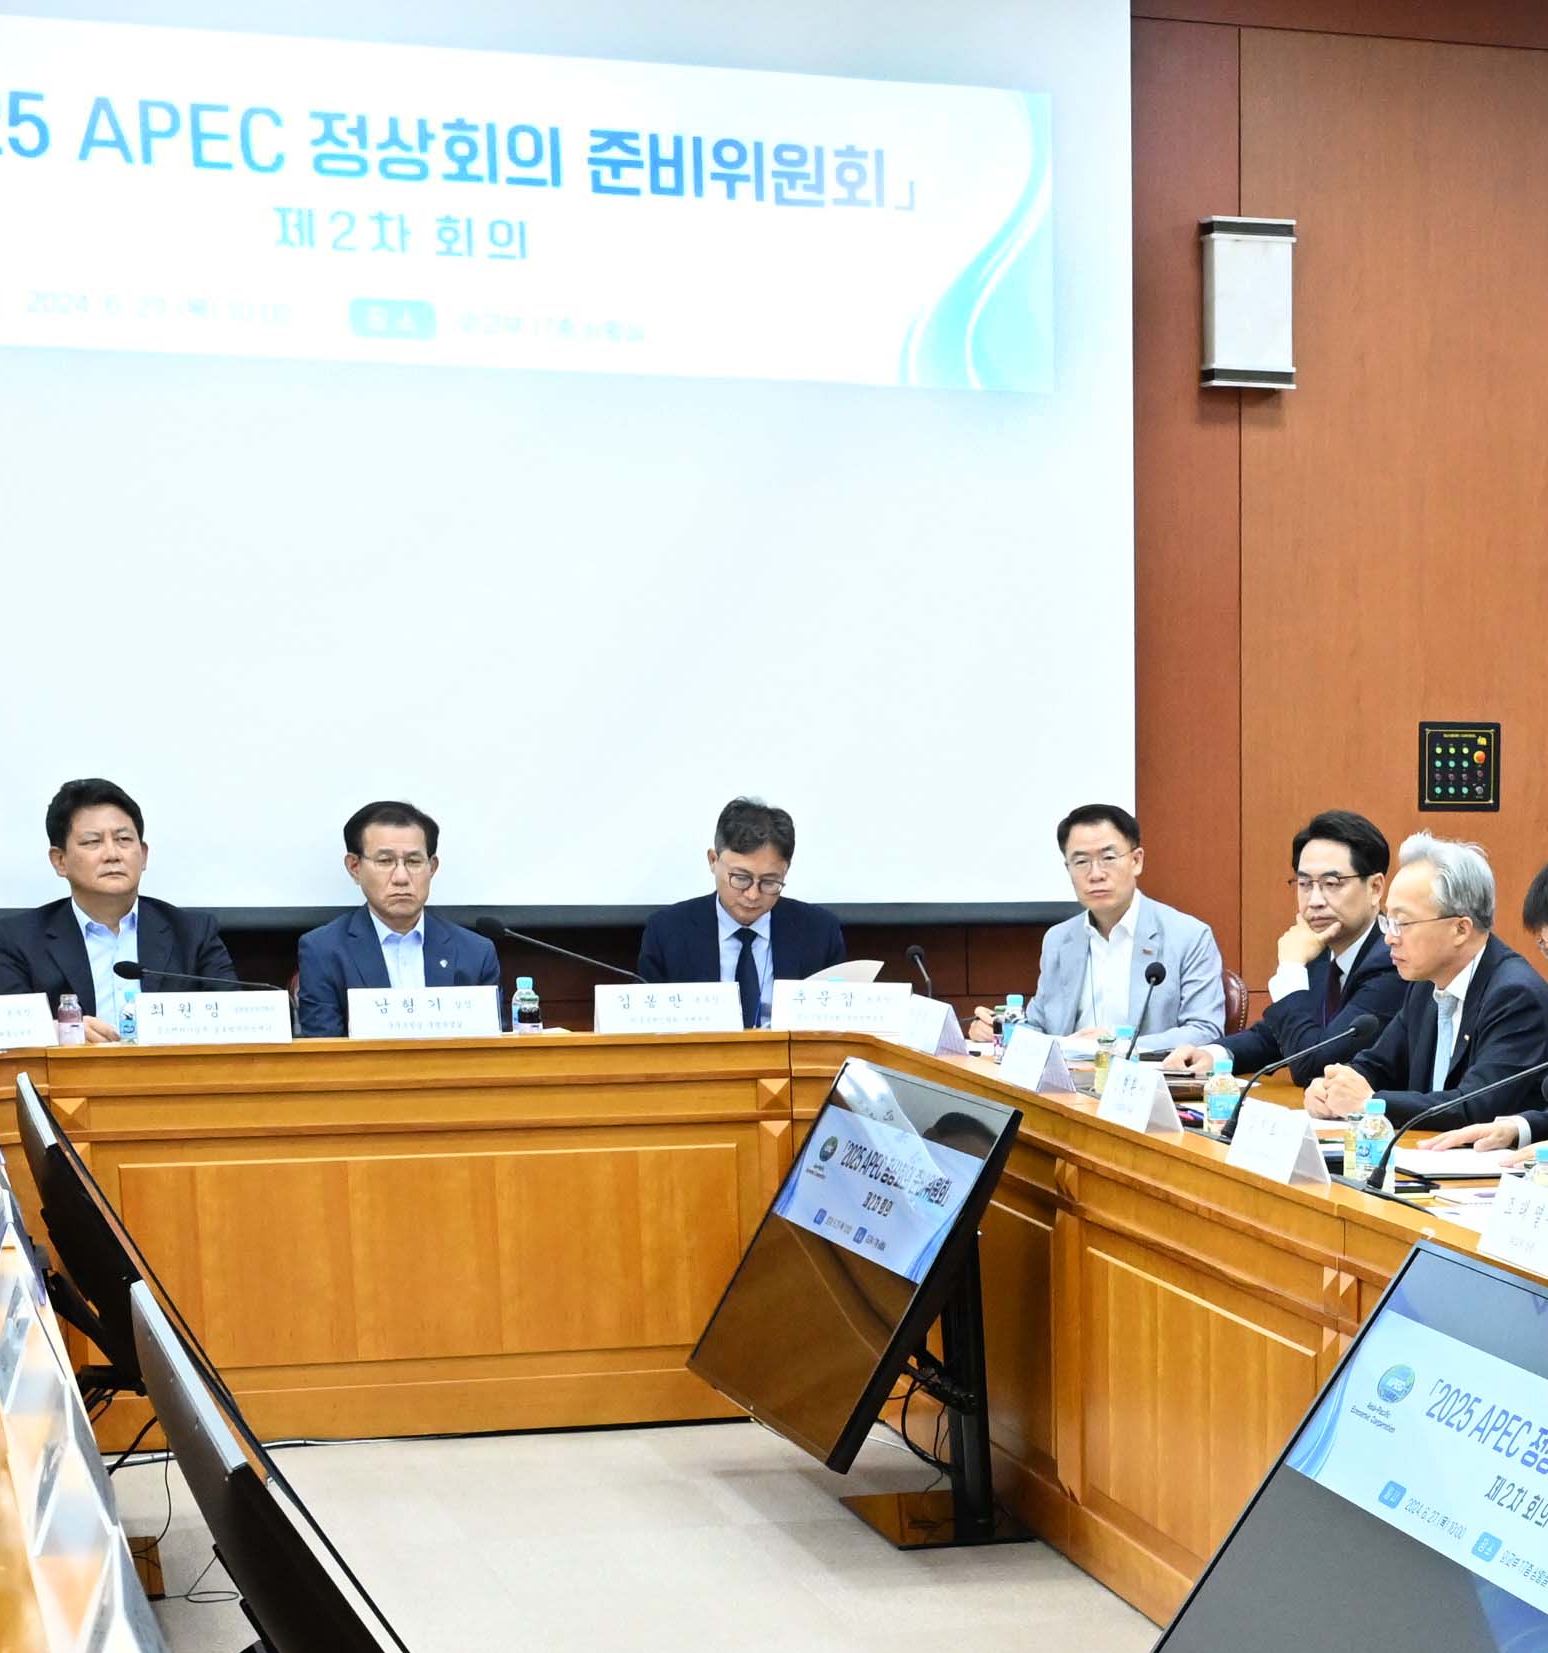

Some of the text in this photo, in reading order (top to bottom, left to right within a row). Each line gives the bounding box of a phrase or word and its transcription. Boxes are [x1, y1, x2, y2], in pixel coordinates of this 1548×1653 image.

[79, 97, 285, 173] APEC
[307, 110, 564, 191] 정상회의
[435, 213, 529, 263] 회의
[1474, 1404, 1534, 1458] APEC
